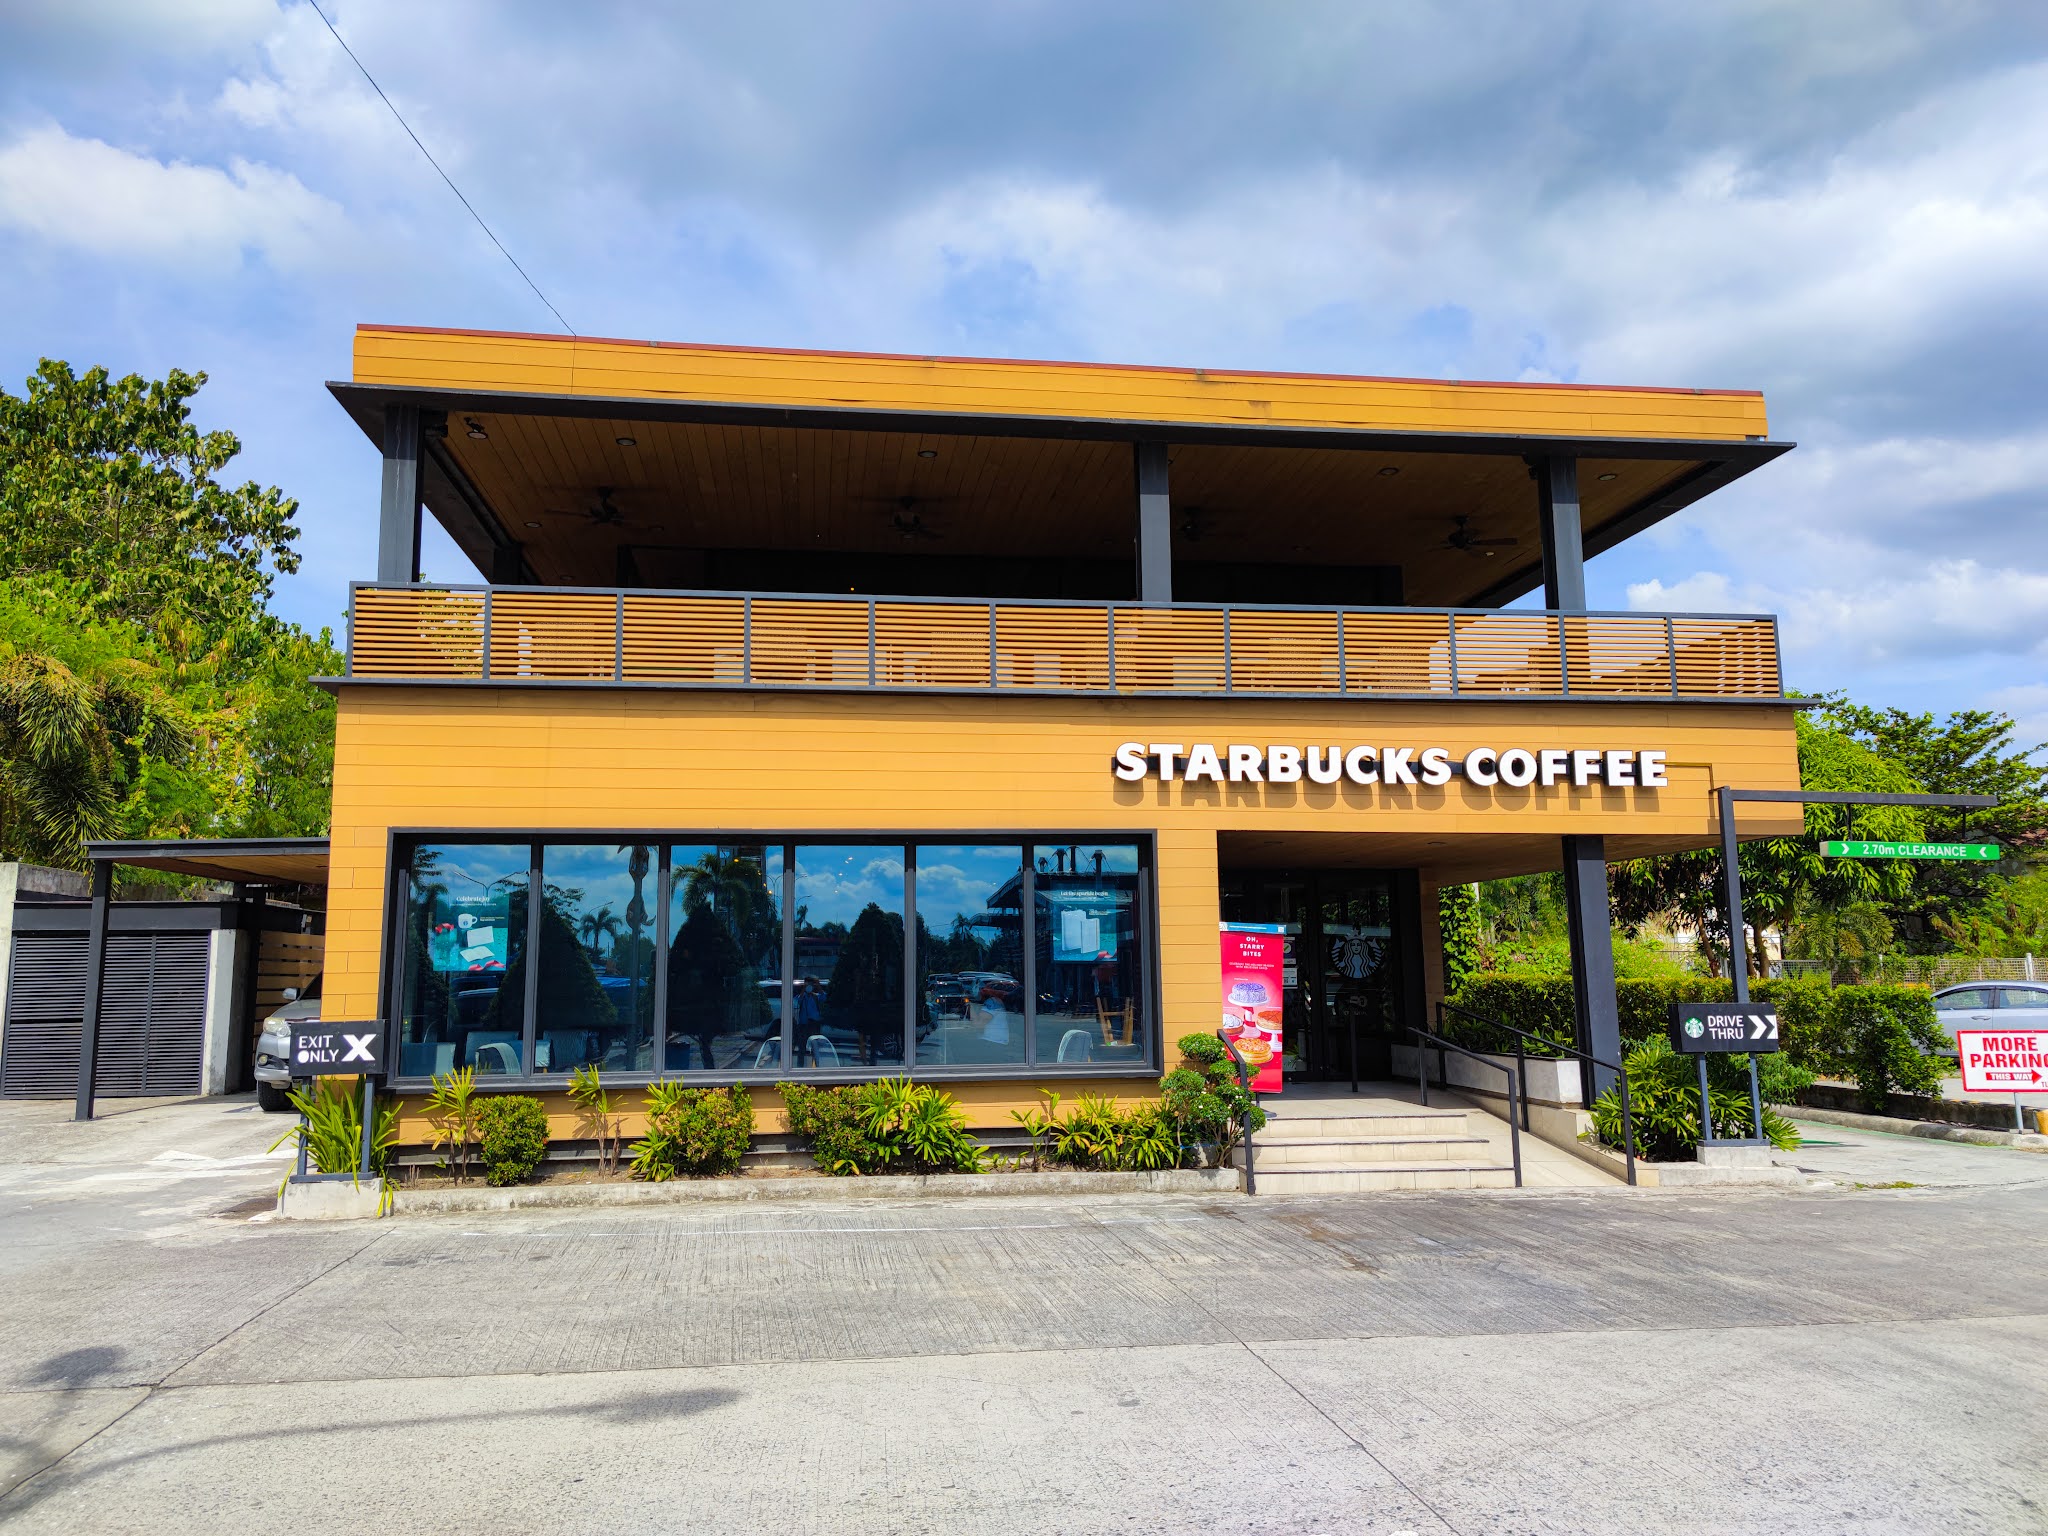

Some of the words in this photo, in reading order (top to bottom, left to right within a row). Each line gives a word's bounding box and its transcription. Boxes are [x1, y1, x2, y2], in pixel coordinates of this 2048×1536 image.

[1115, 742, 1452, 786] STARBUCKS
[1465, 747, 1668, 787] COFFEE
[1863, 844, 1895, 855] 2.70m
[1898, 845, 1967, 857] CLEARANCE
[1707, 1015, 1744, 1027] DRIVE
[1709, 1027, 1744, 1039] THRU
[299, 1035, 333, 1048] EXIT
[1982, 1037, 2038, 1052] MORE
[297, 1049, 339, 1063] ONLY
